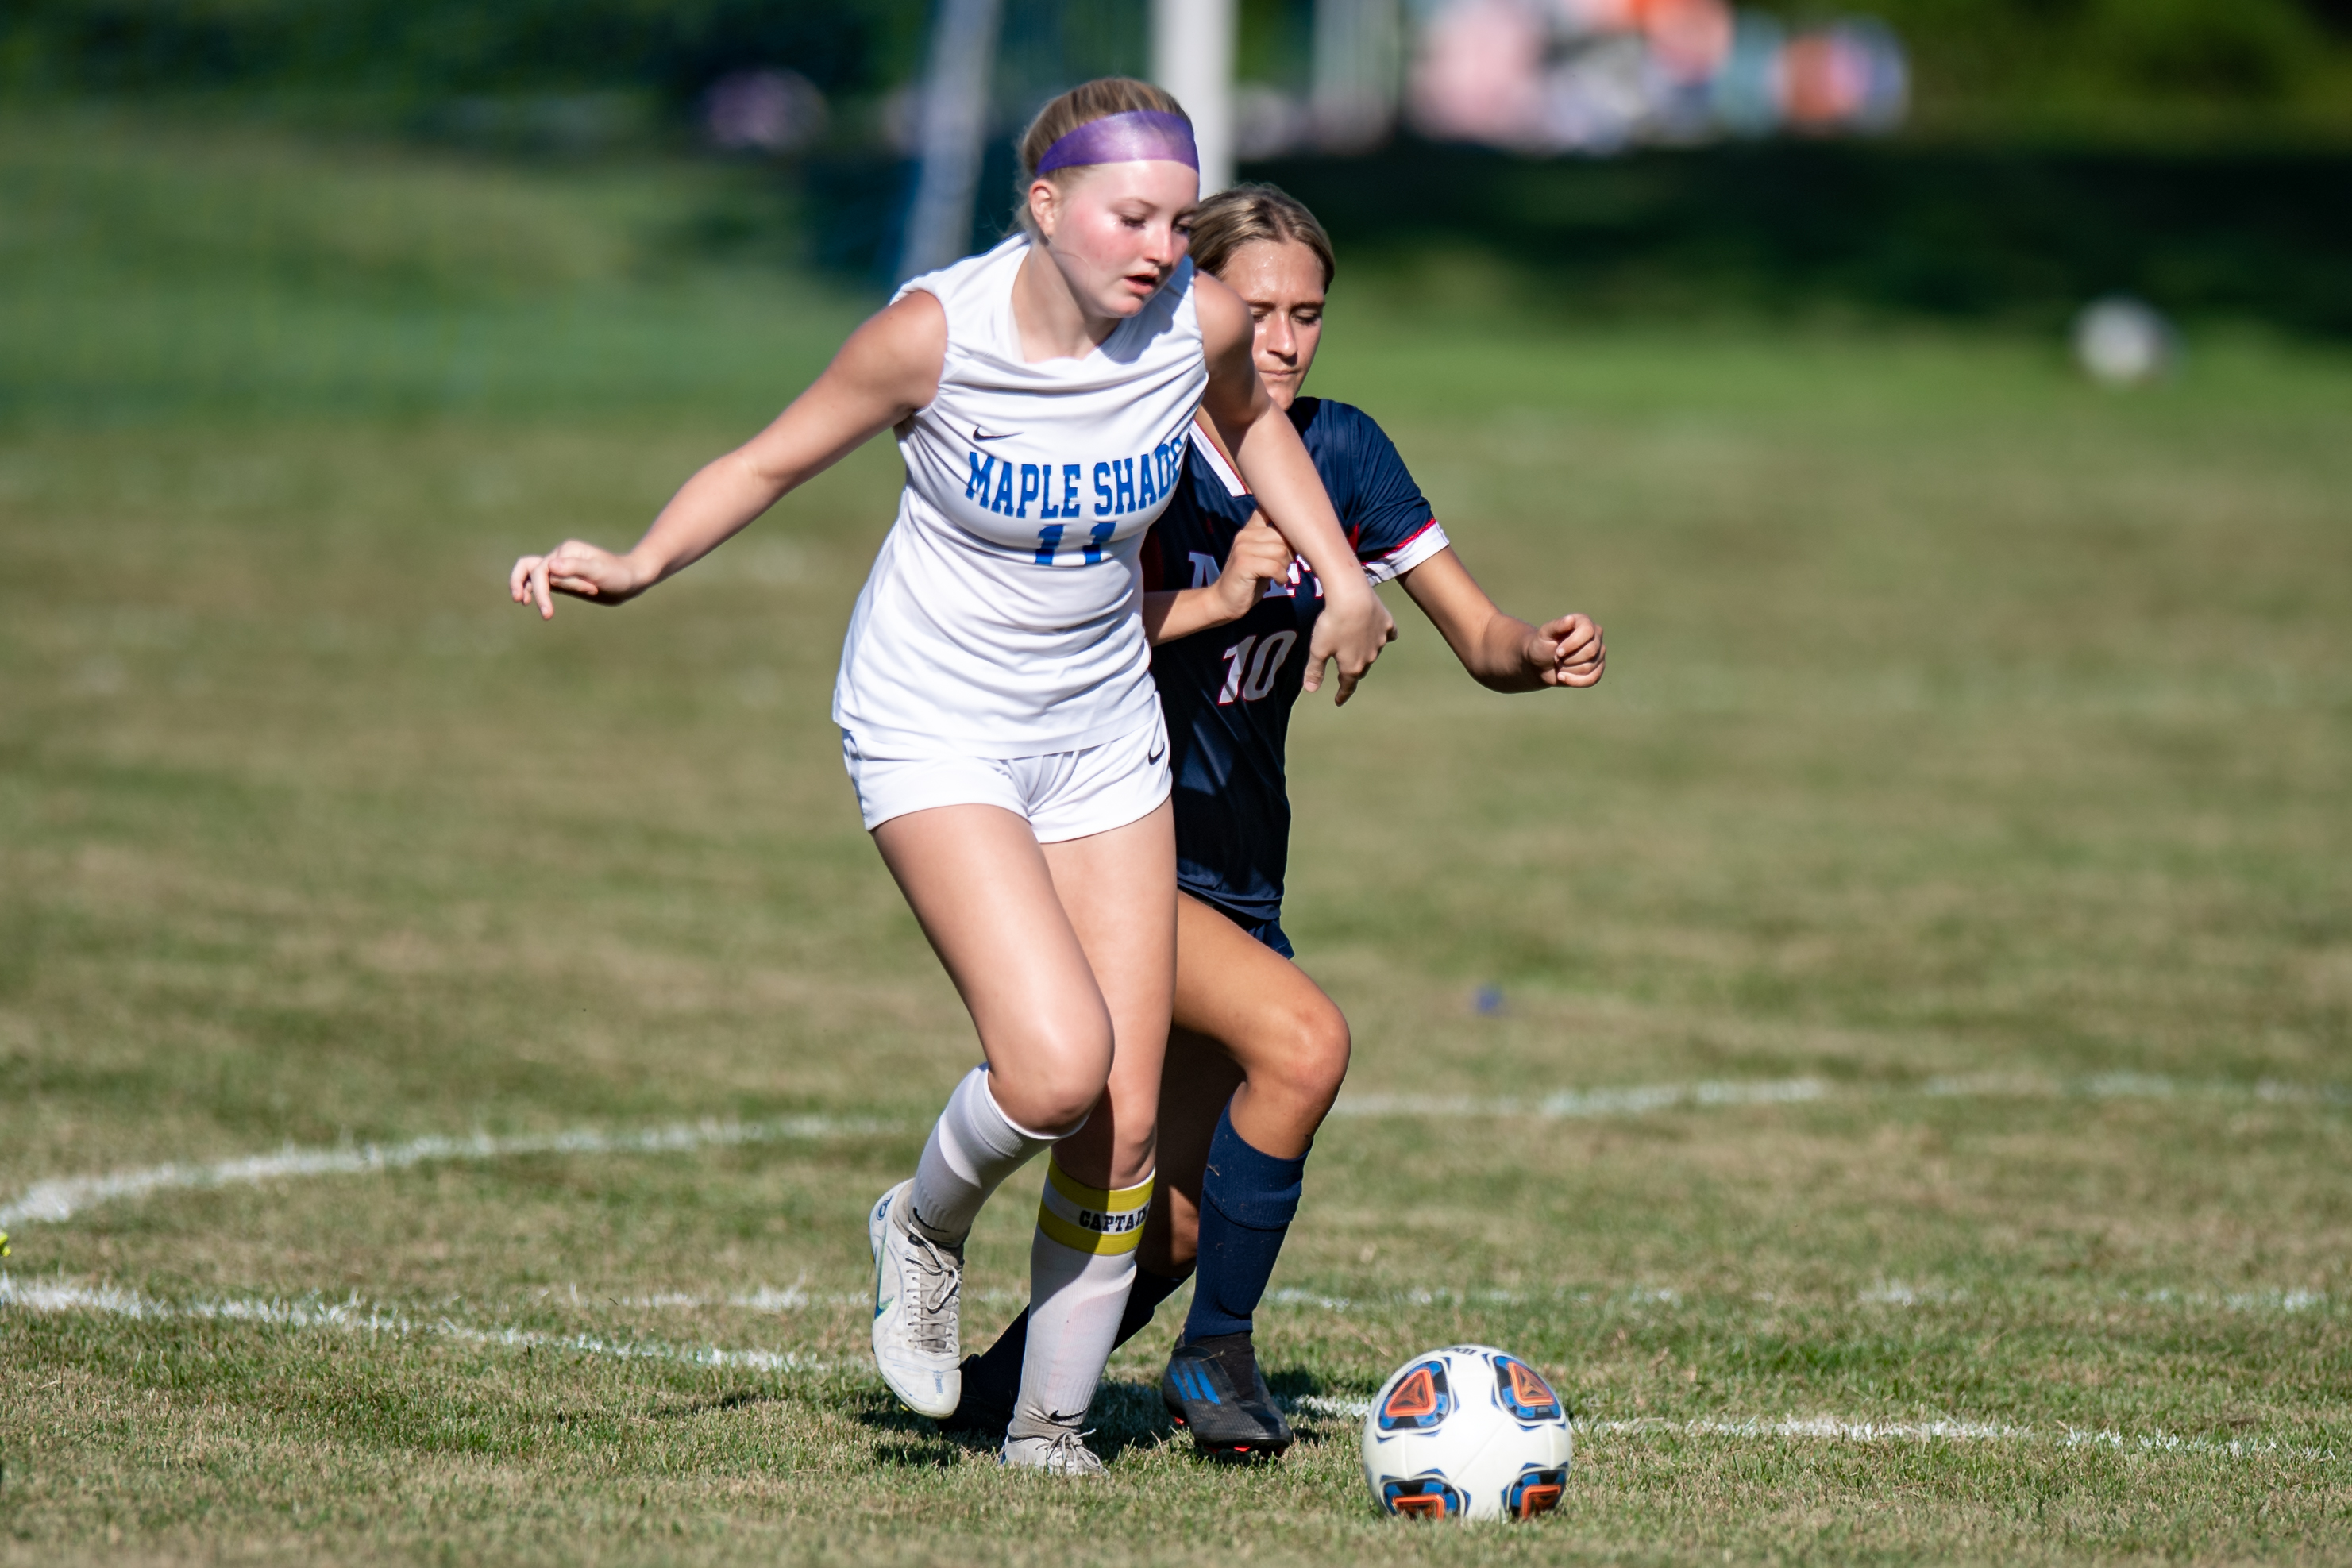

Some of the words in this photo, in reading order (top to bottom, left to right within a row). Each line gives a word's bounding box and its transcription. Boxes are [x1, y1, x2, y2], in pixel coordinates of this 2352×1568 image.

[965, 451, 1081, 518] MAPLE
[1035, 521, 1116, 565] 11
[1218, 630, 1297, 706] 10
